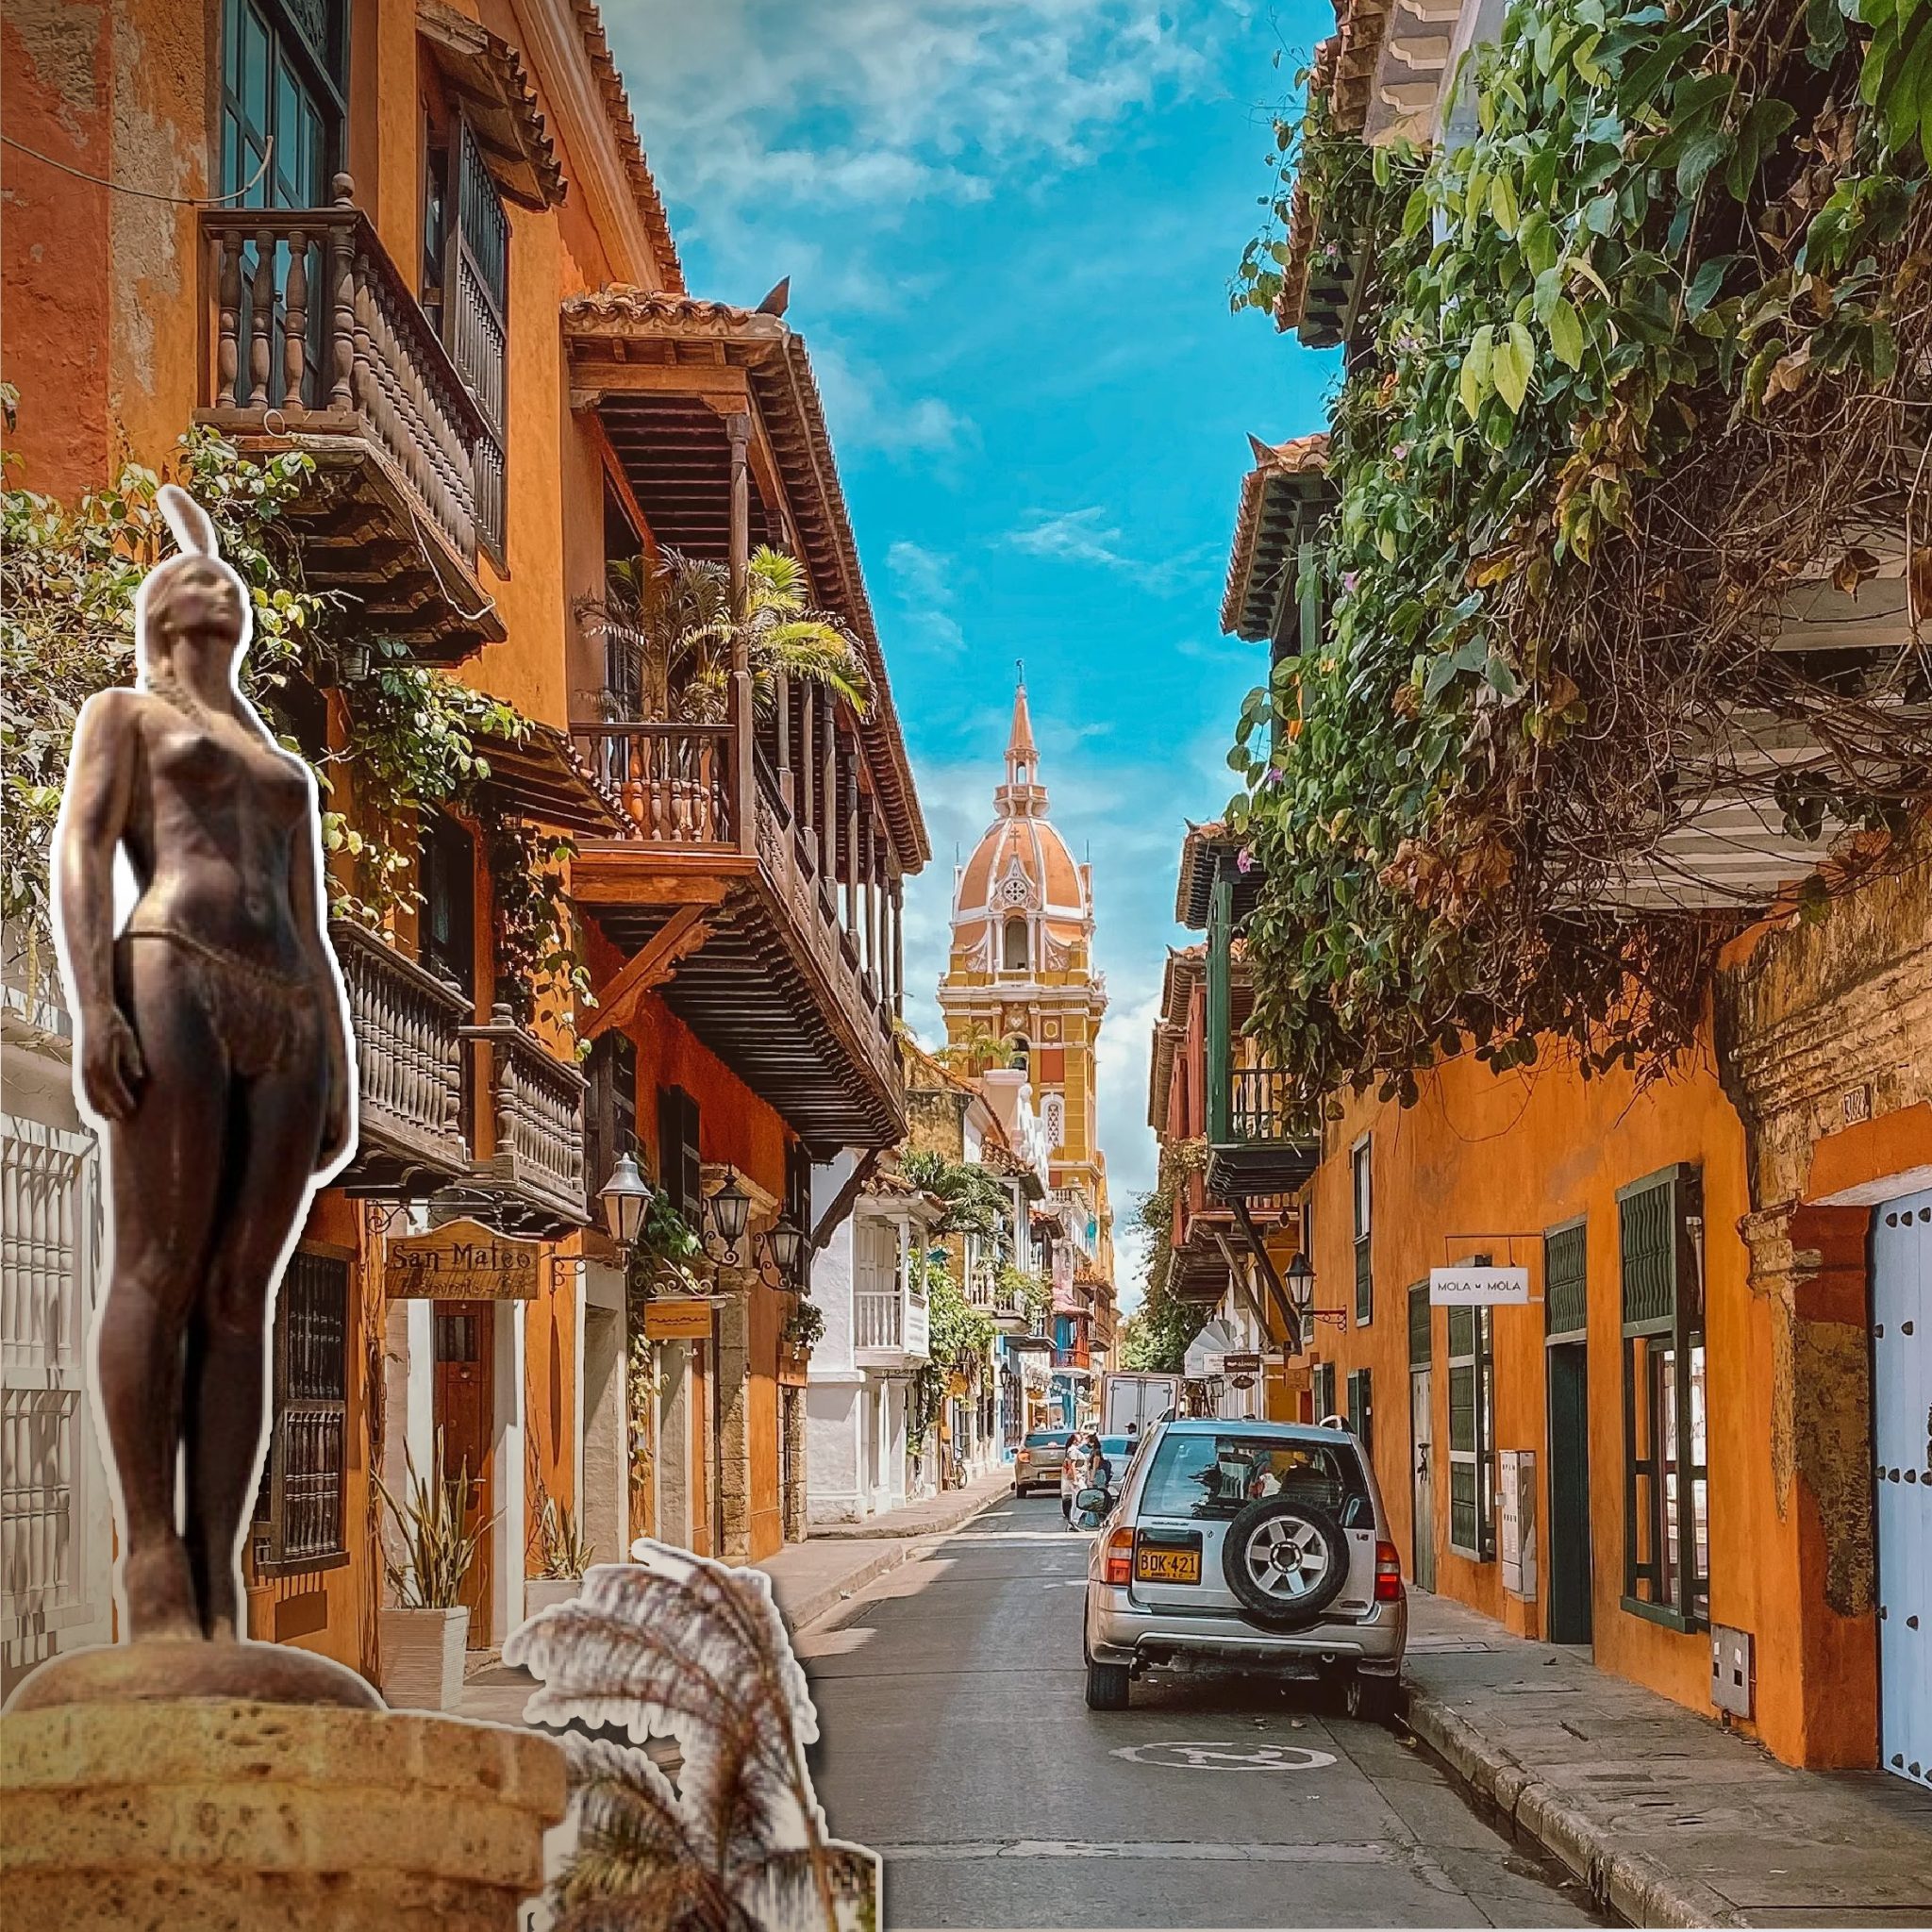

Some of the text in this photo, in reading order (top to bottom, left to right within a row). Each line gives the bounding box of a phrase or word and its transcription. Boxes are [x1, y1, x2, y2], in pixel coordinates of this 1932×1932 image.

[392, 1240, 531, 1272] San Mateo
[1438, 1282, 1472, 1291] MOLA
